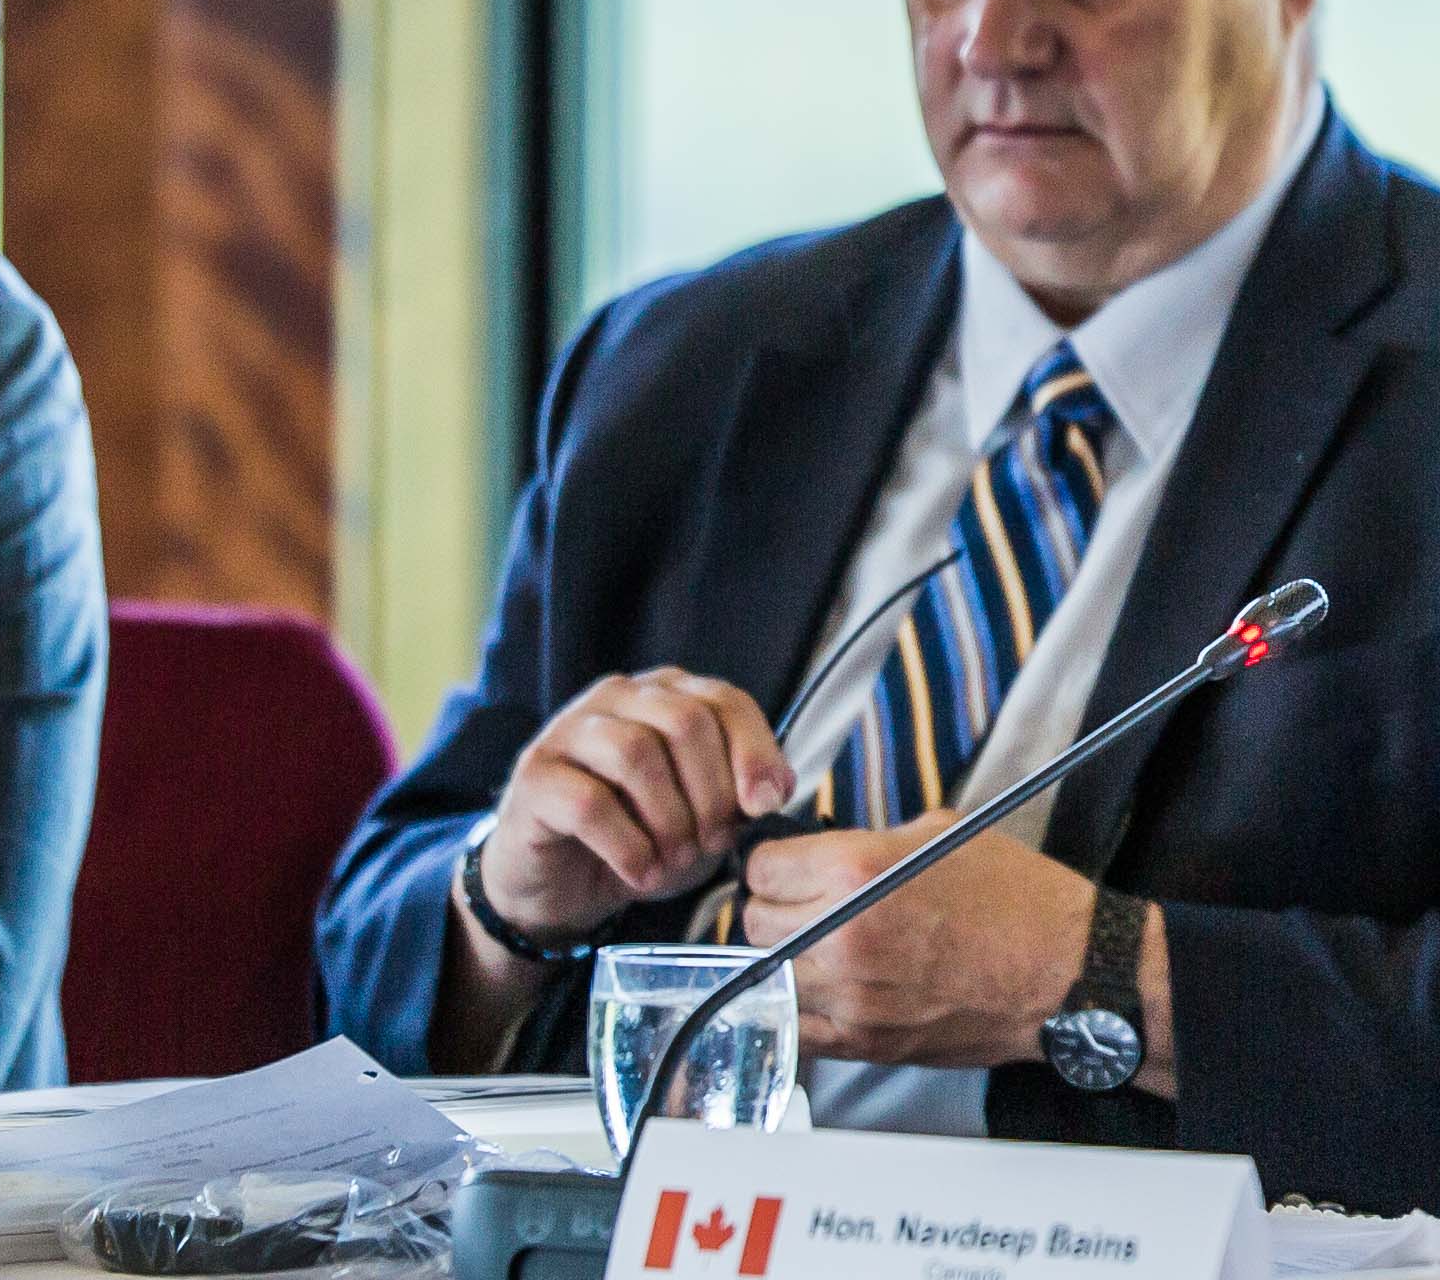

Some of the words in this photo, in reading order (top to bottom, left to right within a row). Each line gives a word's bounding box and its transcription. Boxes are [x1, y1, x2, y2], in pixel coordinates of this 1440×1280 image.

[808, 1207, 882, 1243] Hon.
[895, 1212, 1039, 1263] Navdeep
[1046, 1223, 1140, 1261] Bains
